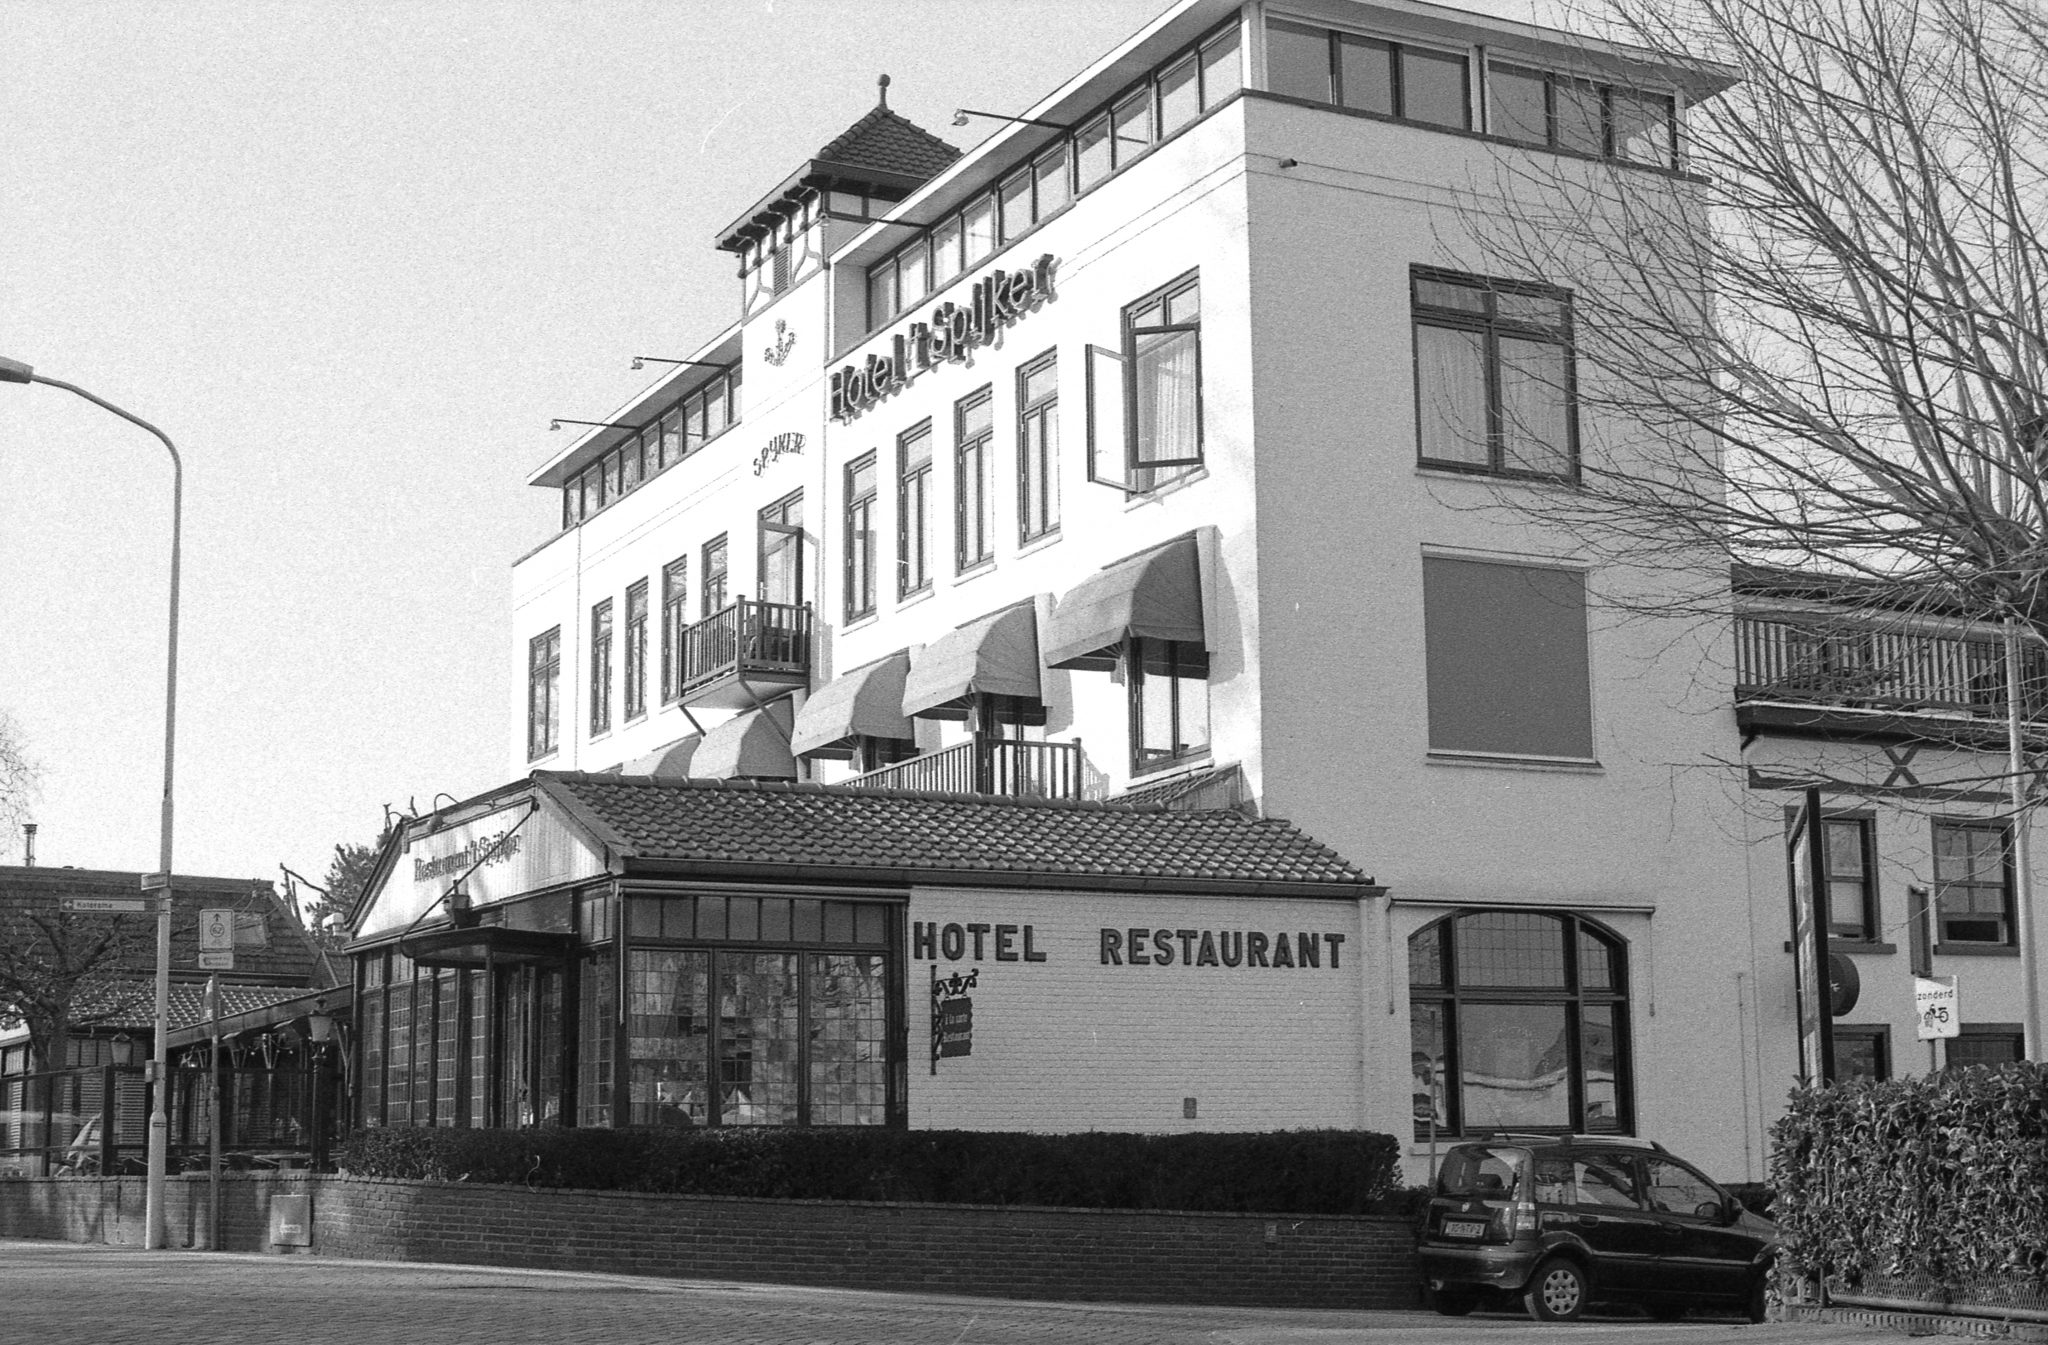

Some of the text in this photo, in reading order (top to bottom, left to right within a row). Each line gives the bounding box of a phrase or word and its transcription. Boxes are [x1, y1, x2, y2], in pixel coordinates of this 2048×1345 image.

[829, 334, 907, 426] Hotel
[913, 921, 1346, 969] HOTEL RESTAURANT
[1917, 989, 1953, 1001] zonderd
